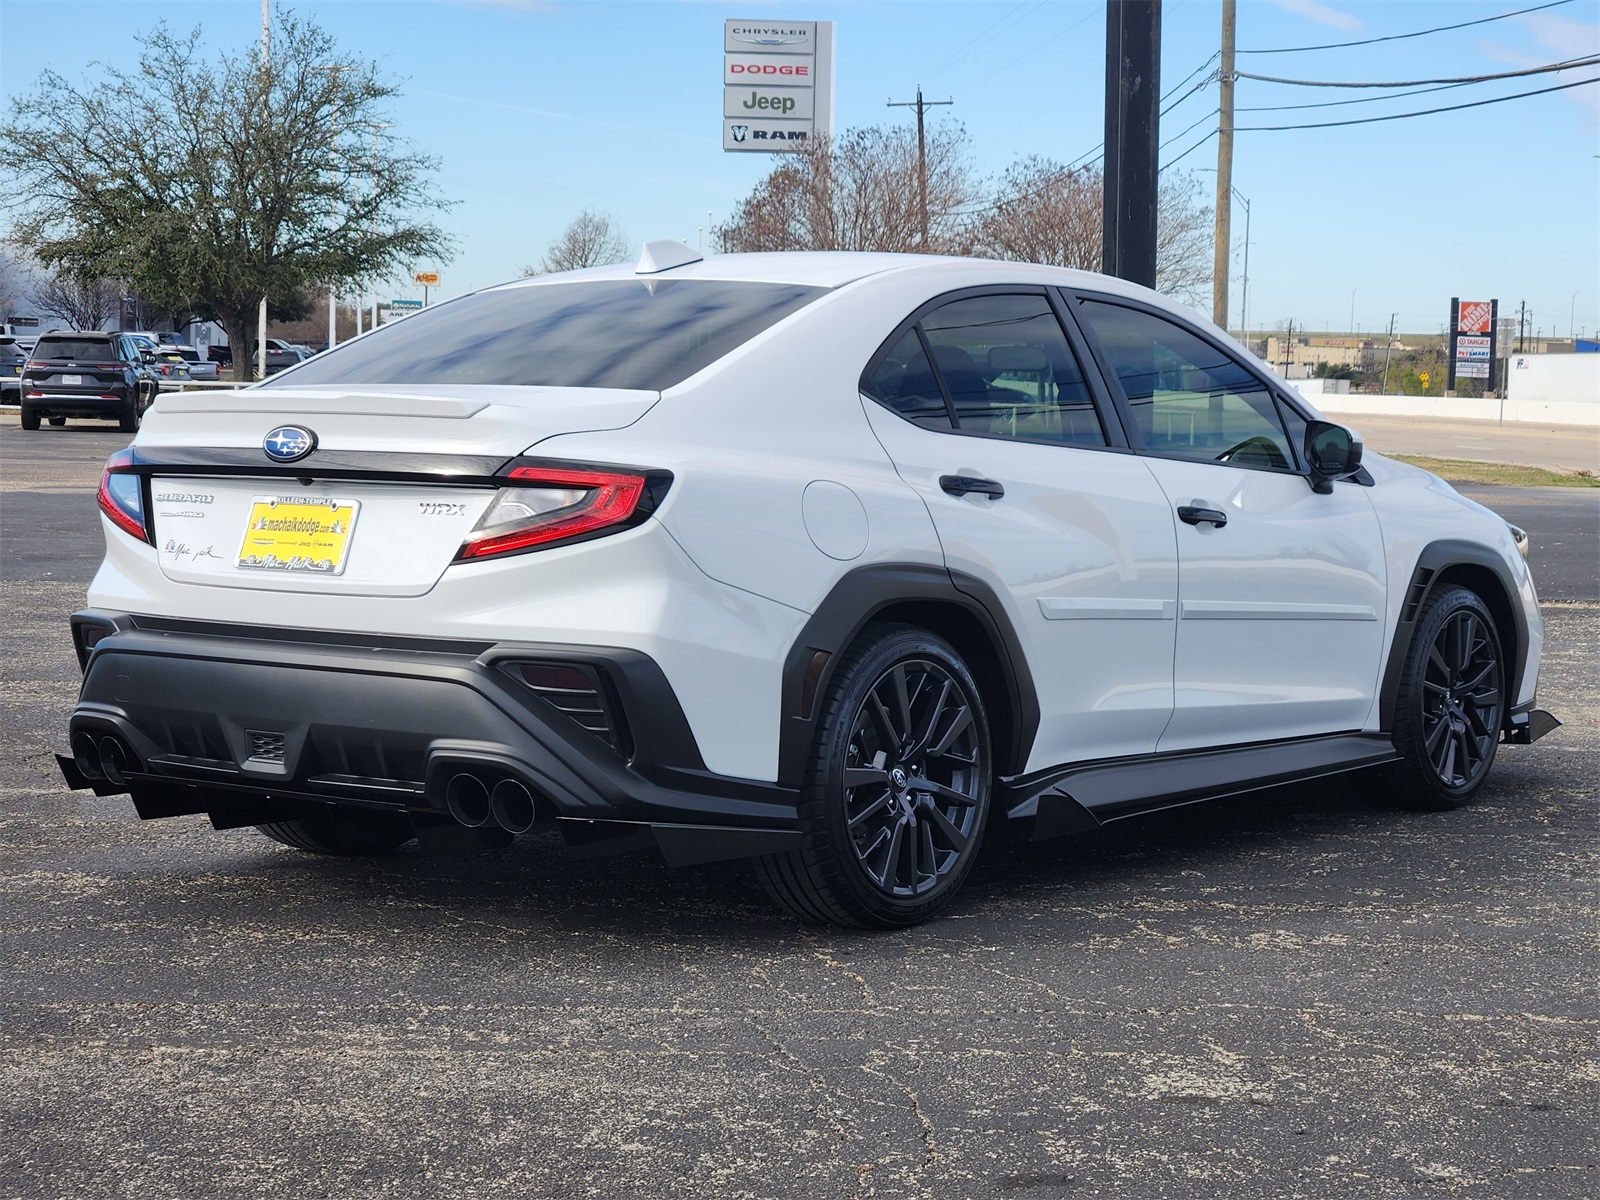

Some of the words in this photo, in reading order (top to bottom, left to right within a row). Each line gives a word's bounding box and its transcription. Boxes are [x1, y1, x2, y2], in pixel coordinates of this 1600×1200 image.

[732, 28, 807, 36] CHRYSLER
[730, 64, 809, 76] DODGE
[743, 91, 796, 114] Jeep
[753, 130, 807, 140] RAM
[1463, 303, 1476, 316] THE
[1460, 302, 1491, 332] HOME
[1471, 312, 1491, 332] DEPOT
[156, 493, 215, 504] SUBARU
[277, 496, 333, 505] KILLEEN-TEMPLE
[419, 502, 467, 516] WRX
[266, 517, 331, 536] machaikdodge.com
[261, 554, 284, 568] Mac
